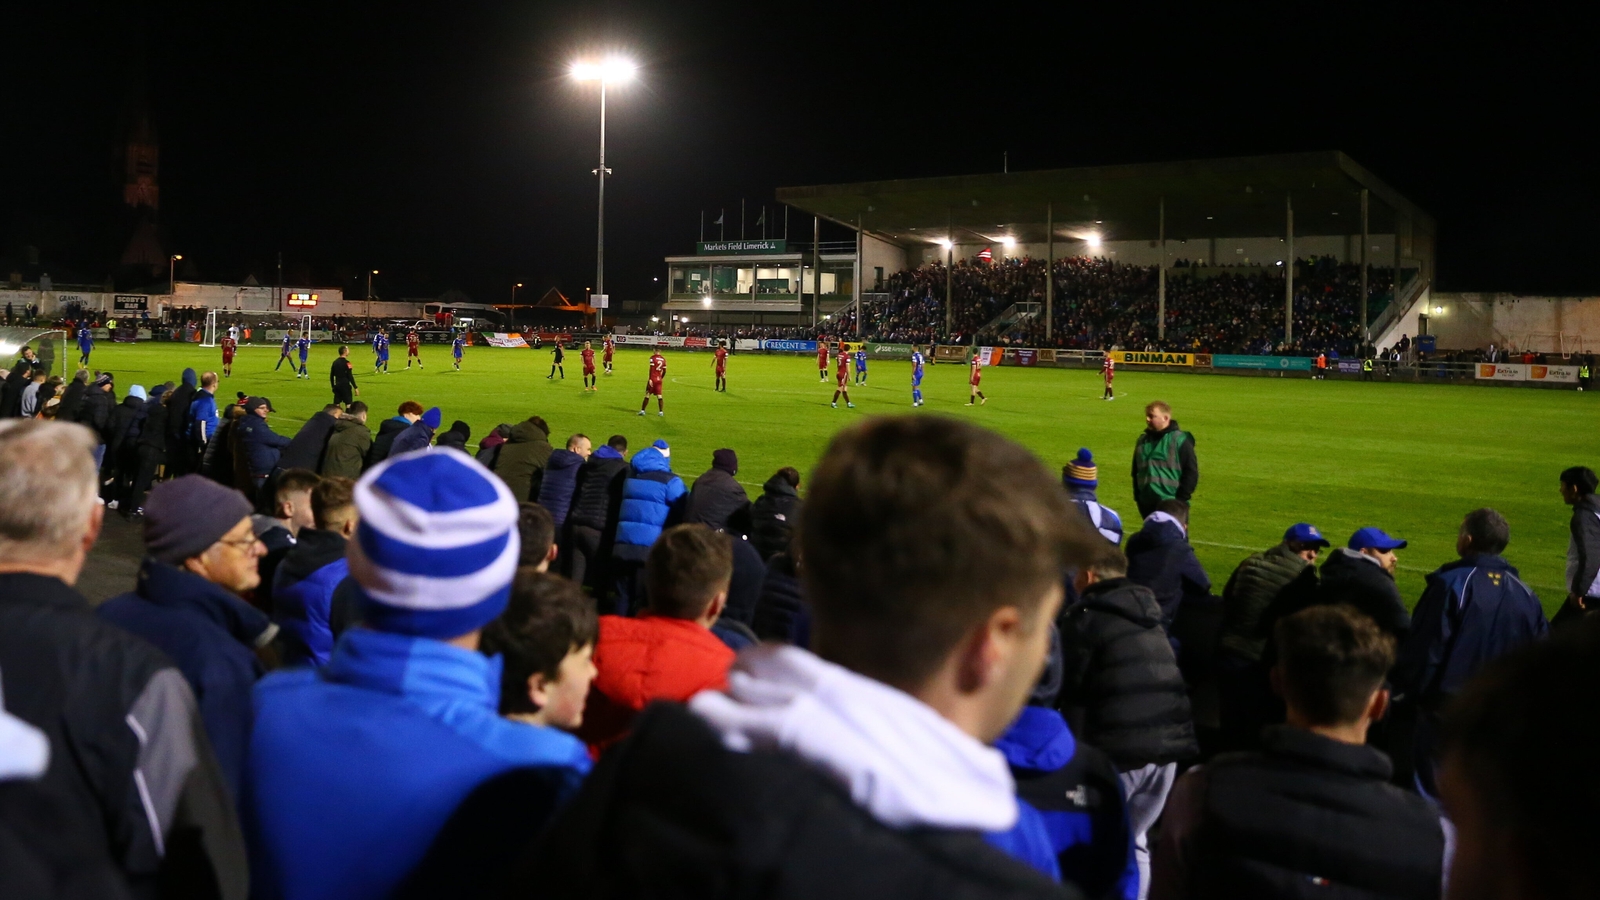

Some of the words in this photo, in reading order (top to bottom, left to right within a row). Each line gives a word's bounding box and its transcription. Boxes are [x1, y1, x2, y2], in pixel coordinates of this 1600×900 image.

[704, 243, 727, 251] Markets
[728, 242, 742, 250] Field
[743, 241, 769, 250] Limerick
[766, 341, 800, 350] CRESCENT
[1124, 352, 1187, 364] BINMAN
[655, 360, 663, 371] 2
